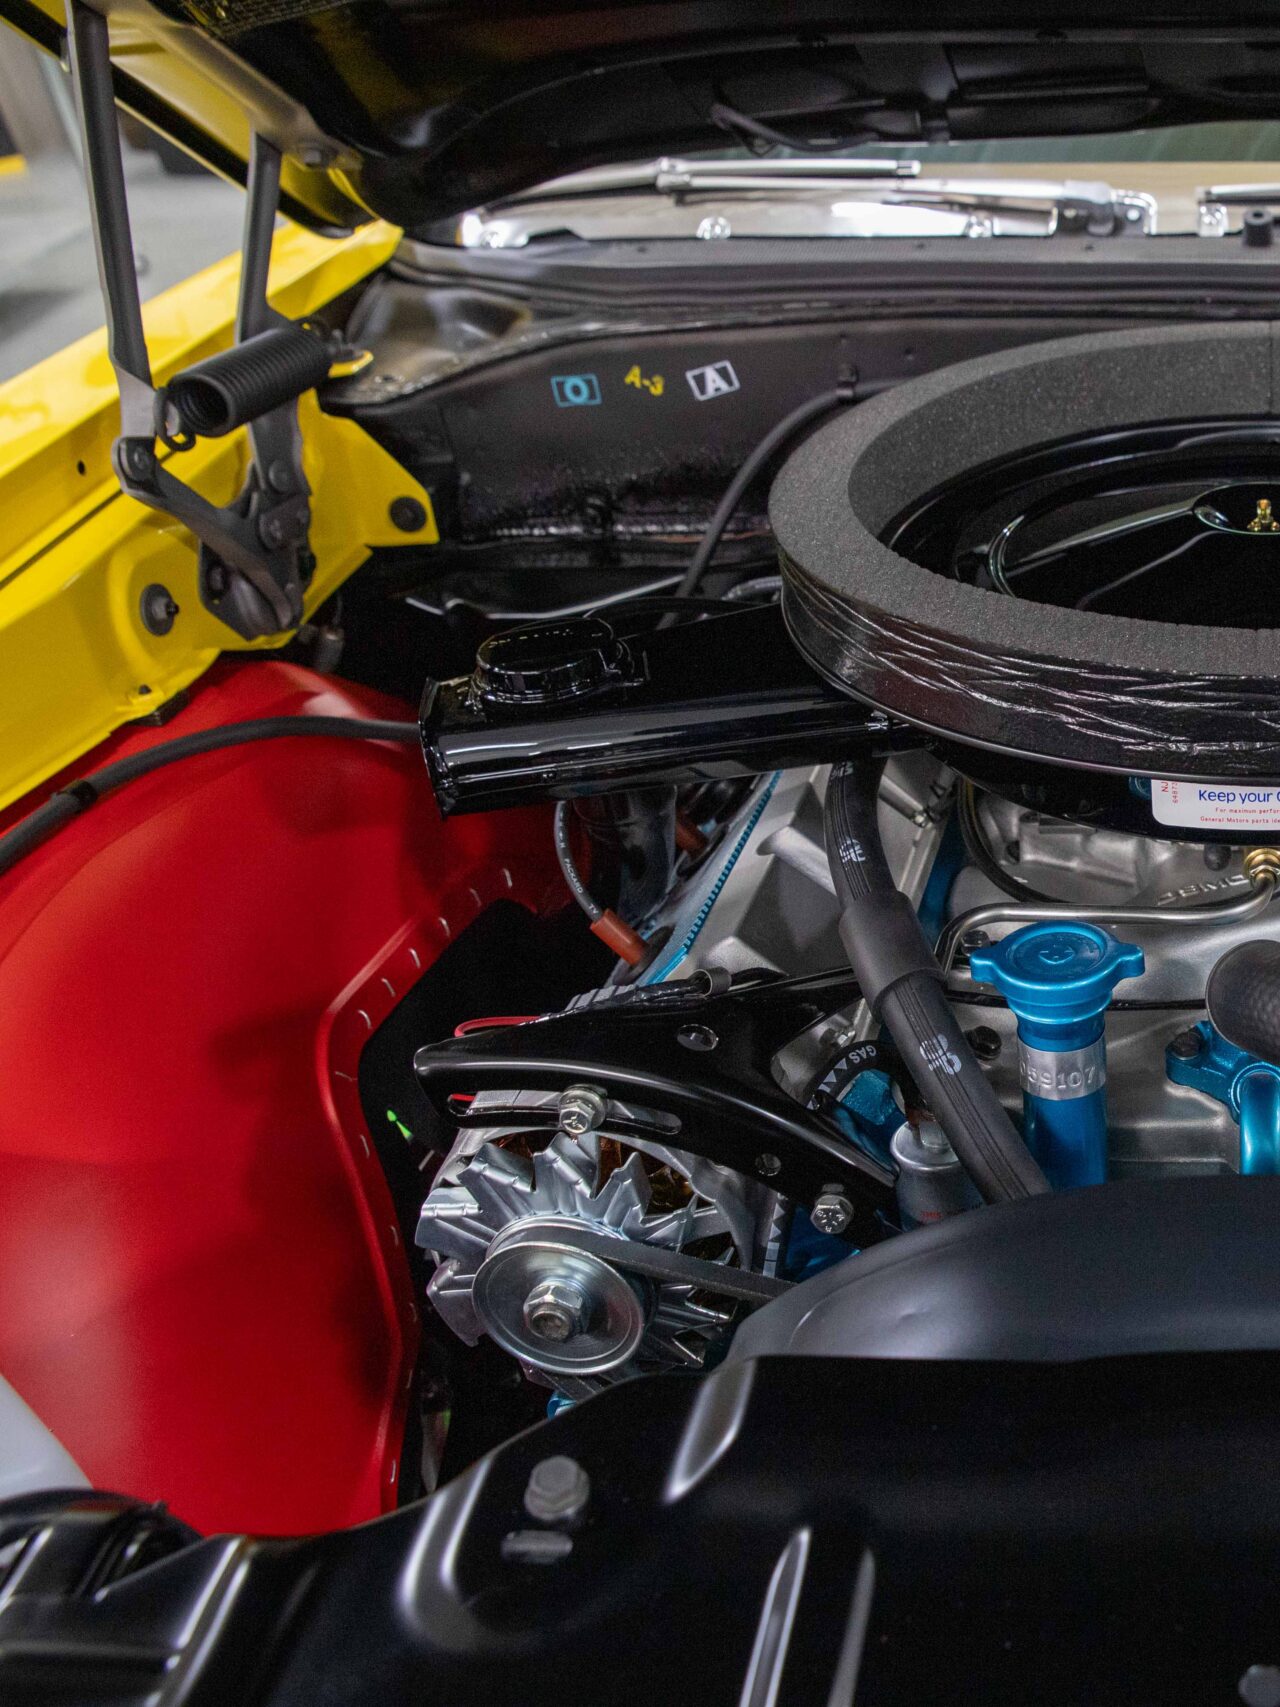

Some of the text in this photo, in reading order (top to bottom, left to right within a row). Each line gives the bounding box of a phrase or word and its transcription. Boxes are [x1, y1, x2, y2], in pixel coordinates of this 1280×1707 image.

[1198, 789, 1236, 804] Keep
[1238, 792, 1273, 804] your
[564, 858, 584, 894] PACKARD
[849, 1044, 878, 1065] GAS
